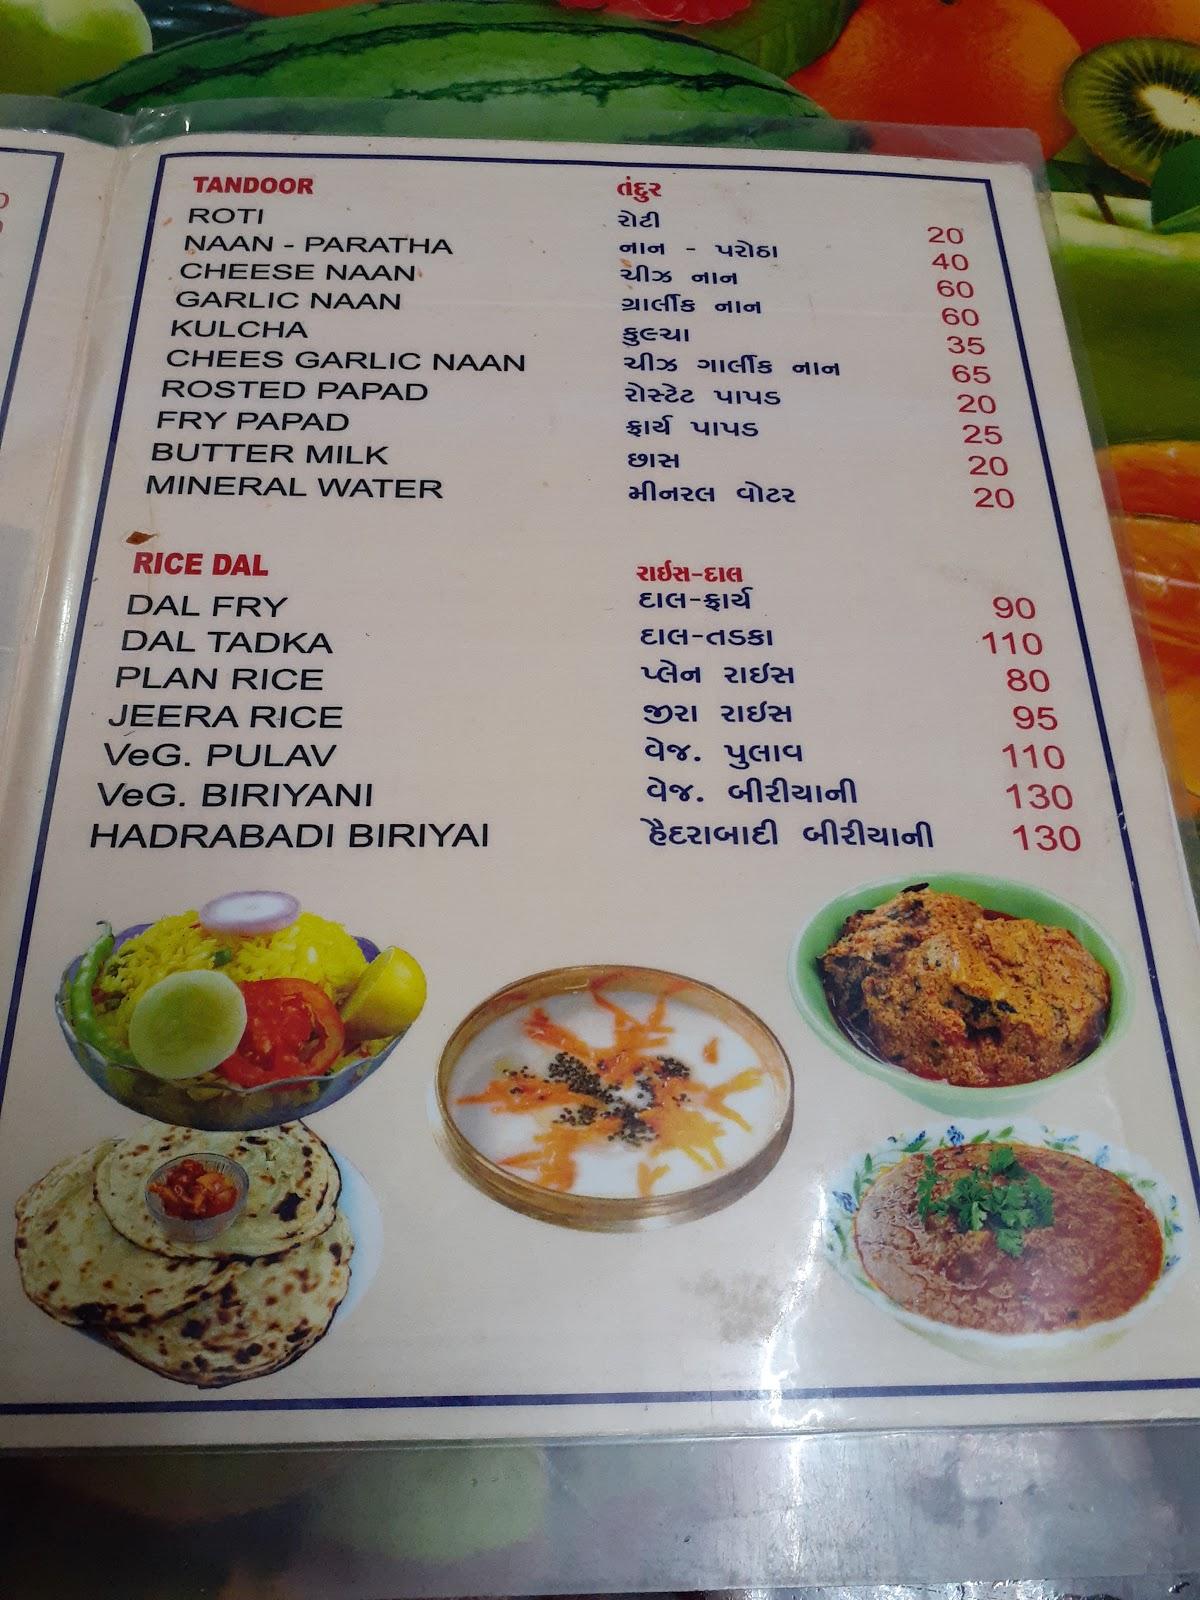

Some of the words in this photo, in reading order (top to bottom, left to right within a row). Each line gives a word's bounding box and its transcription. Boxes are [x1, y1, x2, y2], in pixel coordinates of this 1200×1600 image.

[192, 175, 314, 196] TANDOOR
[188, 207, 264, 225] ROTI
[183, 234, 274, 253] NAAN
[304, 236, 454, 256] PARATHA
[927, 226, 964, 245] 20
[179, 262, 316, 281] CHEESE
[325, 263, 416, 282] NAAN
[931, 252, 970, 272] 40
[175, 290, 300, 310] GARLIC
[310, 292, 401, 311] NAAN
[936, 279, 975, 299] 60
[941, 307, 980, 327] 60
[170, 319, 309, 339] KULCHA
[946, 335, 986, 356] 35
[166, 348, 284, 369] CHEES
[294, 350, 422, 371] GARLIC
[432, 353, 525, 373] NAAN
[951, 364, 992, 385] 65
[161, 379, 306, 400] ROSTED
[317, 381, 429, 402] PAPAD
[956, 393, 997, 415] 20
[156, 410, 228, 430] FRY
[236, 411, 350, 432] PAPAD
[962, 424, 1004, 446] 25
[151, 442, 295, 464] BUTTER
[305, 444, 390, 466] MILK
[967, 455, 1009, 477] 20
[145, 474, 308, 497] MINERAL
[317, 477, 444, 500] WATER
[973, 487, 1015, 510] 20
[132, 551, 204, 576] RICE
[211, 553, 269, 577] DAL
[126, 593, 201, 617] DAL
[212, 595, 289, 618] FRY
[992, 596, 1036, 620] 90
[121, 629, 196, 653] DAL
[206, 631, 334, 655] TADKA
[981, 631, 1044, 656] 110
[115, 665, 218, 690] PLAN
[231, 667, 324, 691] RICE
[1006, 668, 1051, 693] 80
[108, 703, 240, 729] JEERA
[249, 705, 344, 729] RICE
[1012, 705, 1059, 731] 95
[103, 742, 191, 767] VeG.
[206, 743, 338, 768] PULAV
[1001, 743, 1066, 770] 110
[96, 782, 186, 808] VeG.
[201, 783, 373, 808] BIRIYANI
[1005, 783, 1074, 811] 130
[89, 823, 334, 849] HADRABADI
[348, 822, 489, 849] BIRIYAI
[1012, 824, 1082, 853] 130
